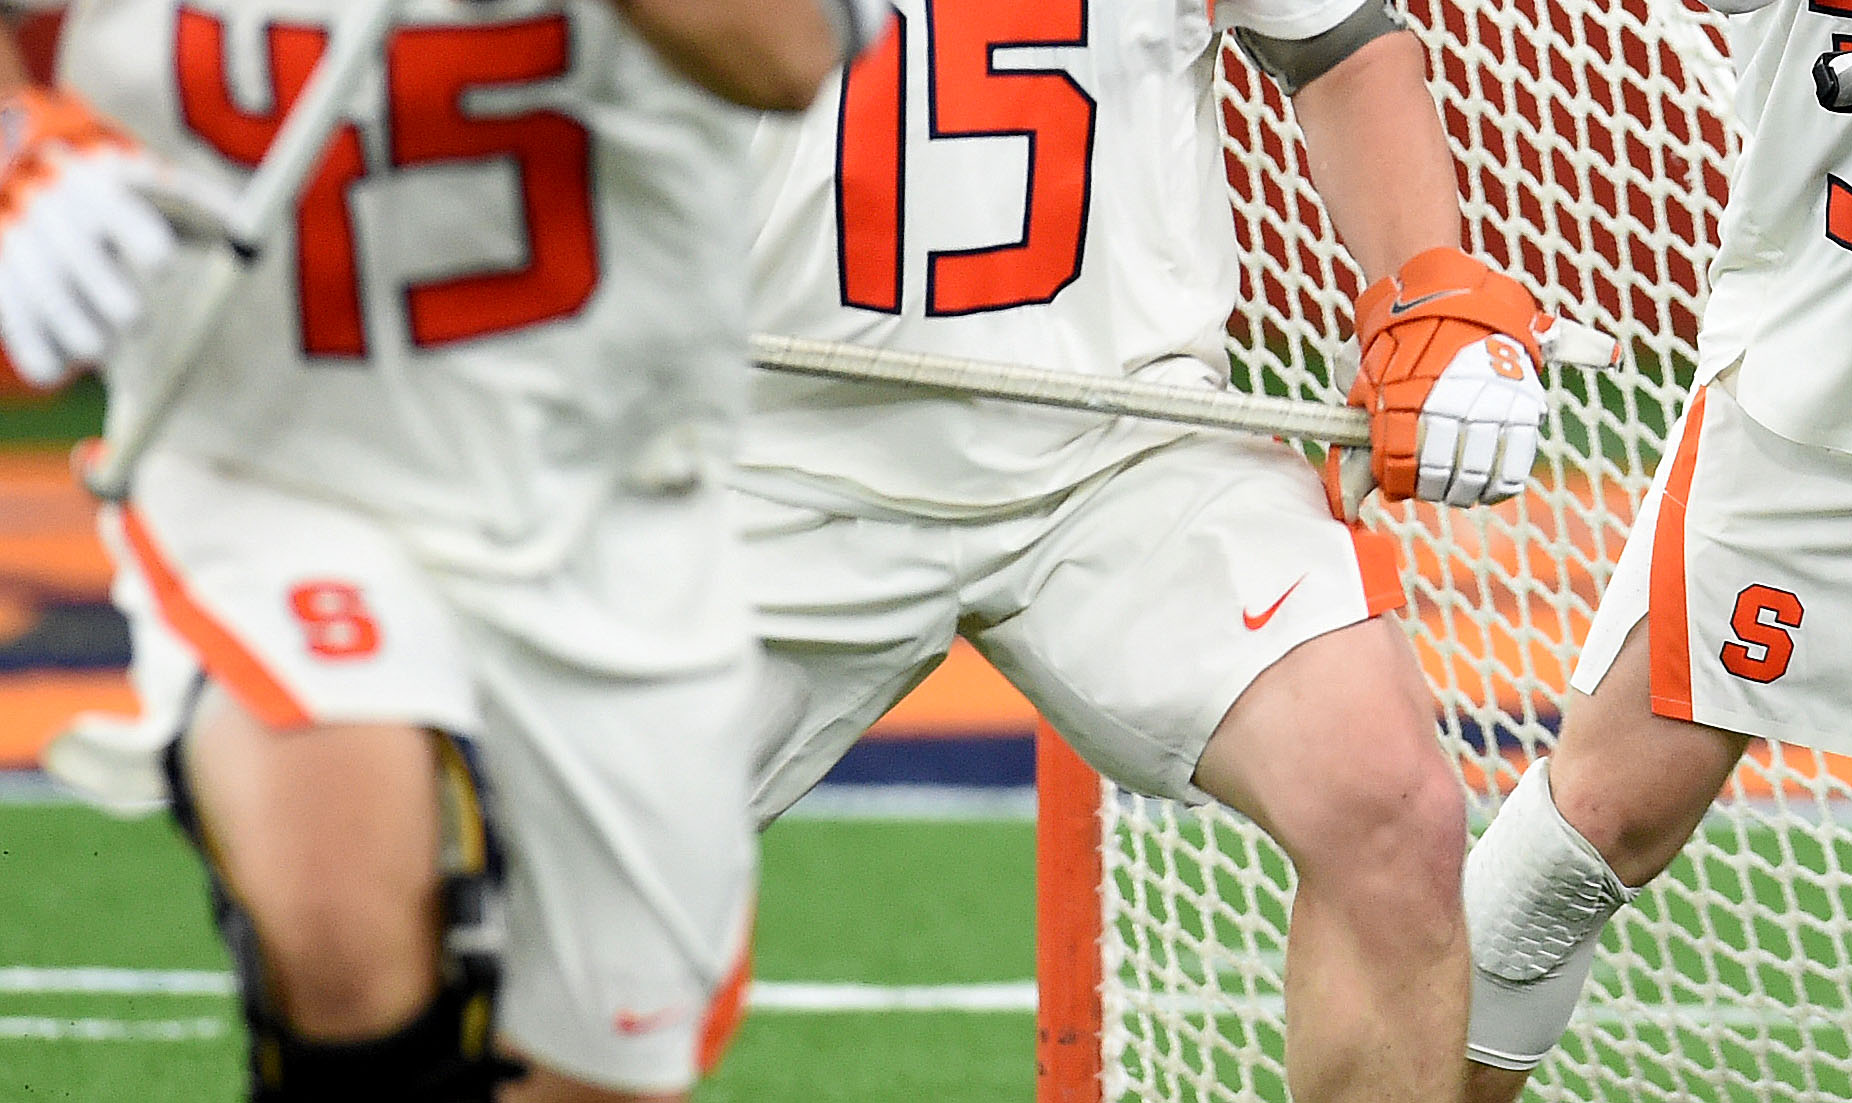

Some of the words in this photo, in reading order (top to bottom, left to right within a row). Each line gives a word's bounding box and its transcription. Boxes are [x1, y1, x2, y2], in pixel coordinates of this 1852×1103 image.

[174, 0, 601, 360] 45
[1484, 338, 1524, 381] S
[287, 578, 382, 664] S
[1719, 584, 1805, 684] S
